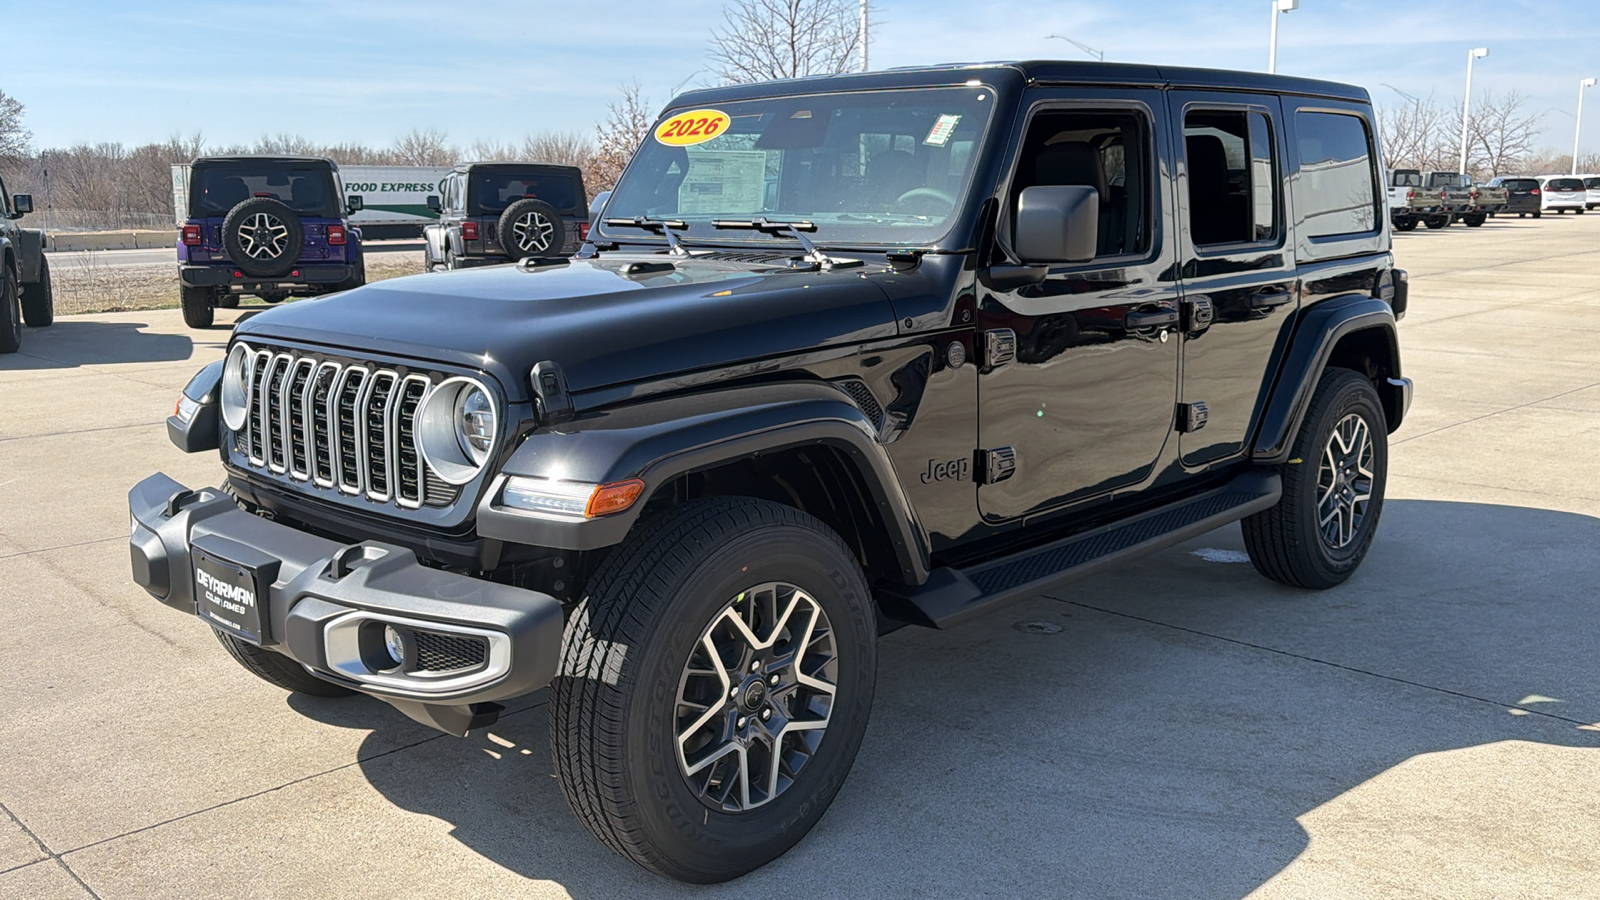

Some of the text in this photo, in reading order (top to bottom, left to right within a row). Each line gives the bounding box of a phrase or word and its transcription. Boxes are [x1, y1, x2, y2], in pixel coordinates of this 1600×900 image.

[661, 117, 723, 138] 2026
[344, 182, 434, 192] FOOD EXPRESS
[920, 457, 969, 484] Jeep
[197, 568, 254, 607] DEYARMAN
[223, 600, 246, 615] AMES
